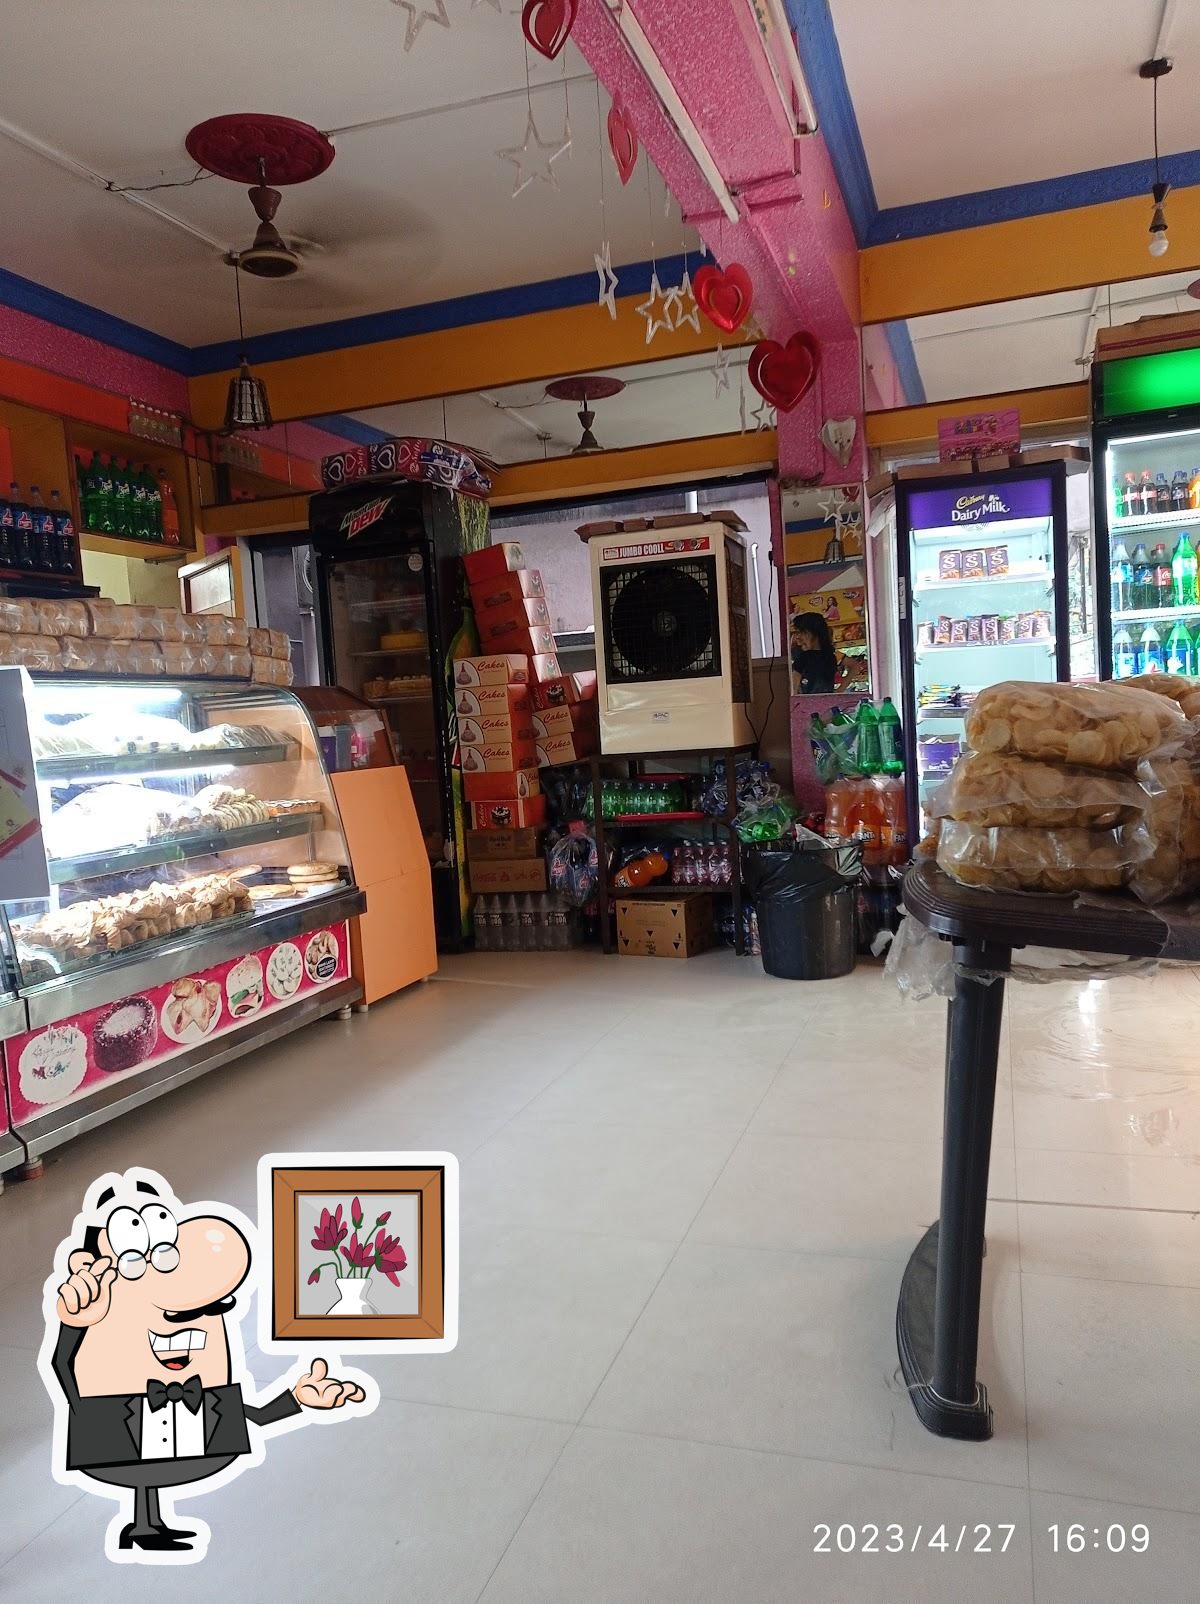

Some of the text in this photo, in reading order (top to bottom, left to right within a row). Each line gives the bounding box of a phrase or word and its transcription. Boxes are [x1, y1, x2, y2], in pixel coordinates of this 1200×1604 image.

[951, 501, 1011, 522] Dairy Milk
[619, 545, 643, 558] JUMBO
[477, 659, 506, 672] Cakes
[478, 690, 506, 702] Cakes
[481, 718, 509, 730] Cakes
[543, 711, 570, 725] Cakes
[545, 739, 571, 753] Cakes
[483, 747, 510, 760] Cakes
